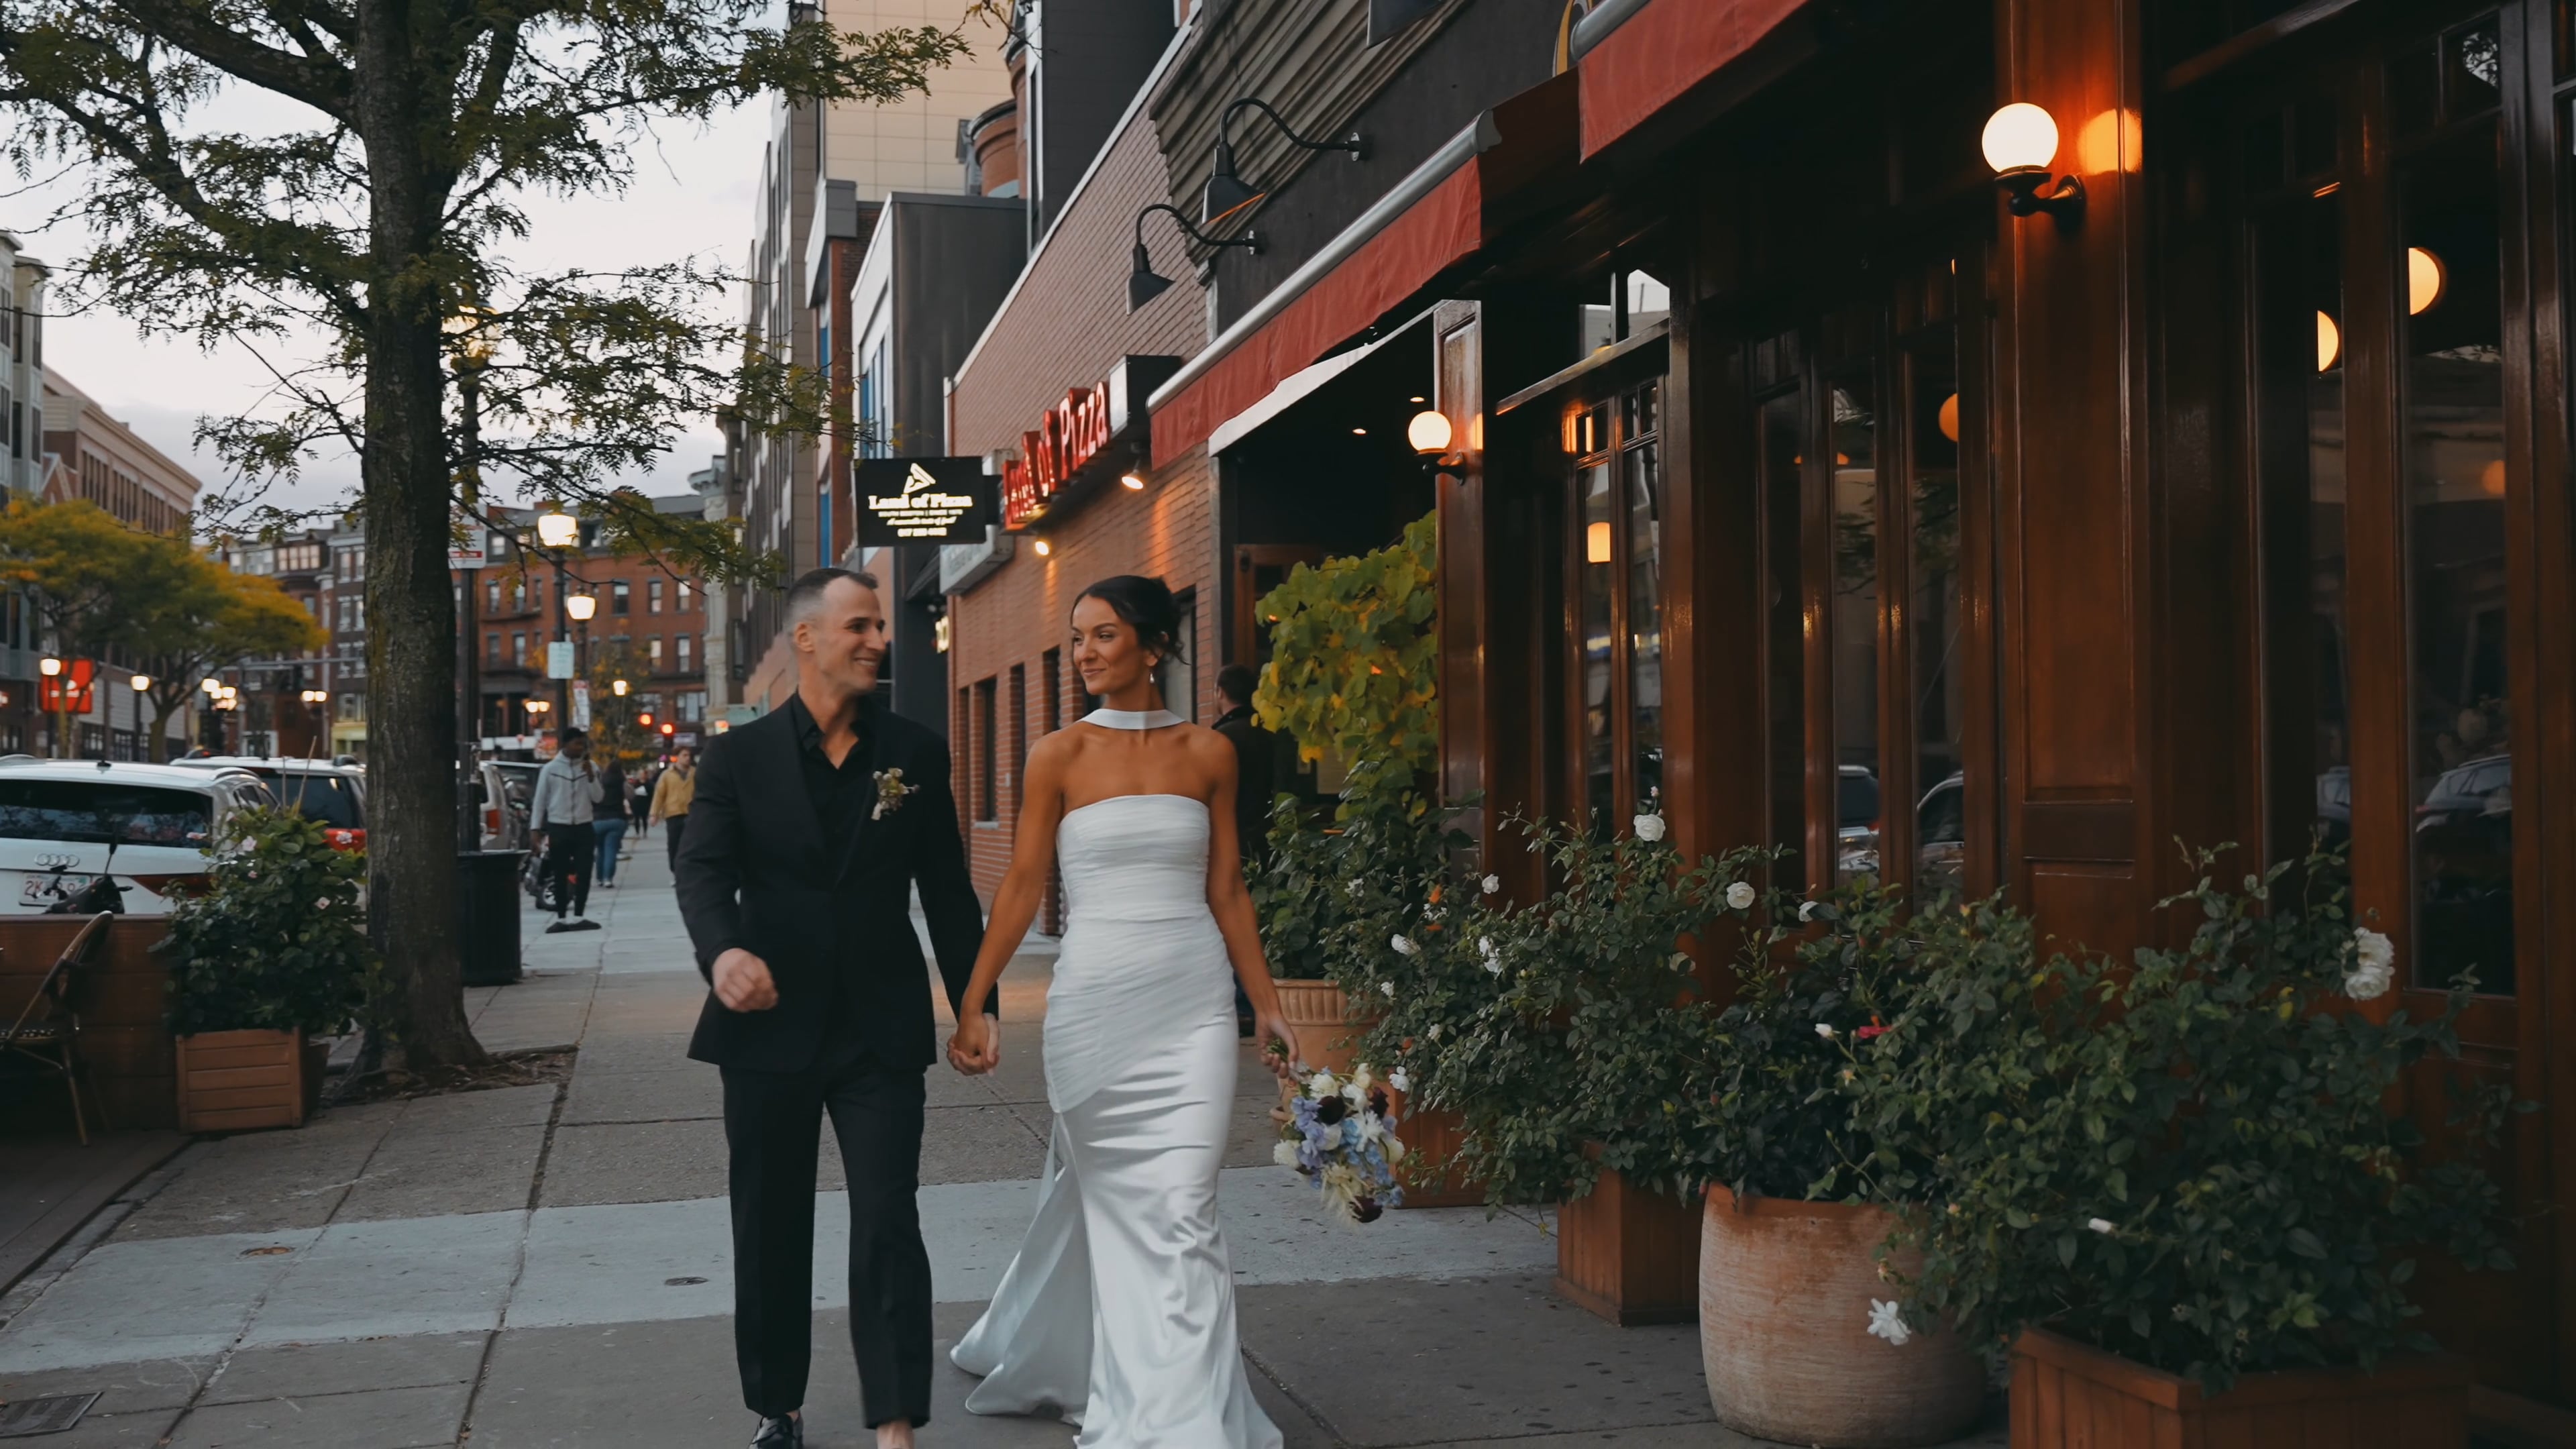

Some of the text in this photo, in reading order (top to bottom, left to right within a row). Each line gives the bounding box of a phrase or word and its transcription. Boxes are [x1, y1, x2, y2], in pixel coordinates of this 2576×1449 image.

[1059, 381, 1108, 481] Pizza
[868, 494, 910, 509] Land
[910, 493, 930, 508] of
